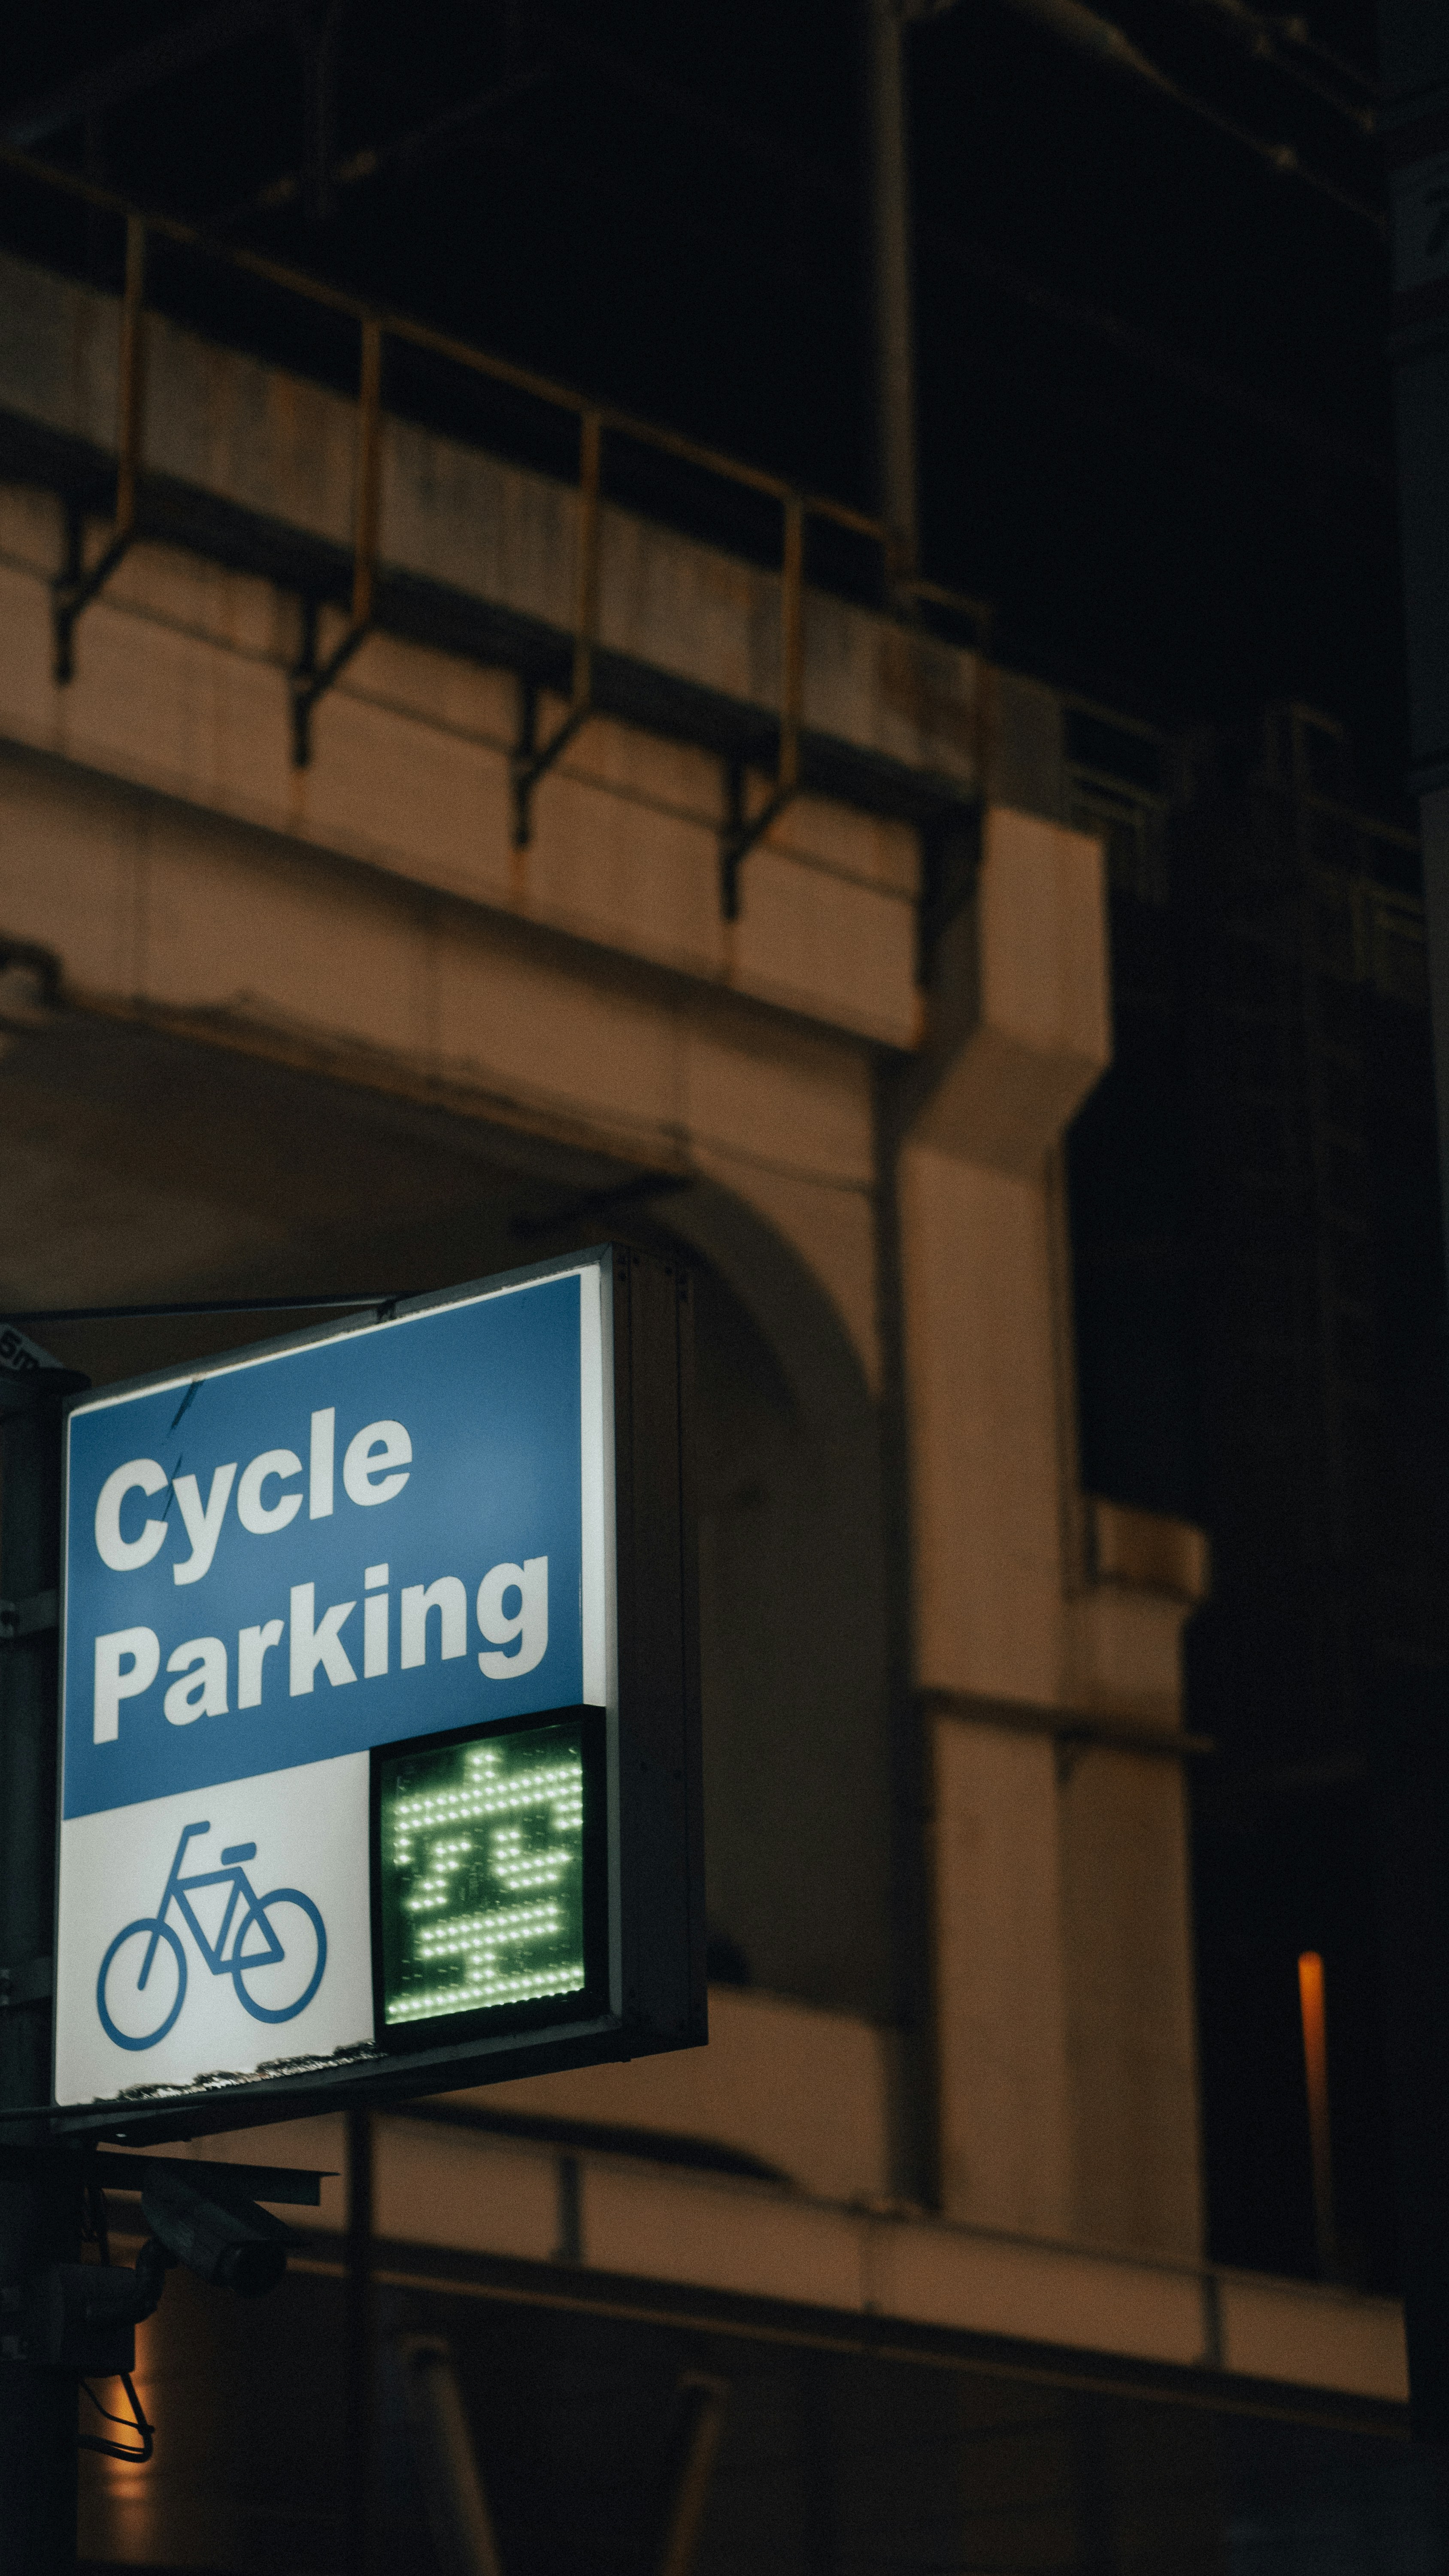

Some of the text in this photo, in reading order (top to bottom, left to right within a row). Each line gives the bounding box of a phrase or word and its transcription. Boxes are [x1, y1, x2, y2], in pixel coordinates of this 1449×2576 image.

[95, 1406, 413, 1586] Cycle
[93, 1555, 549, 1744] Parking
[385, 1747, 584, 2024] 空
